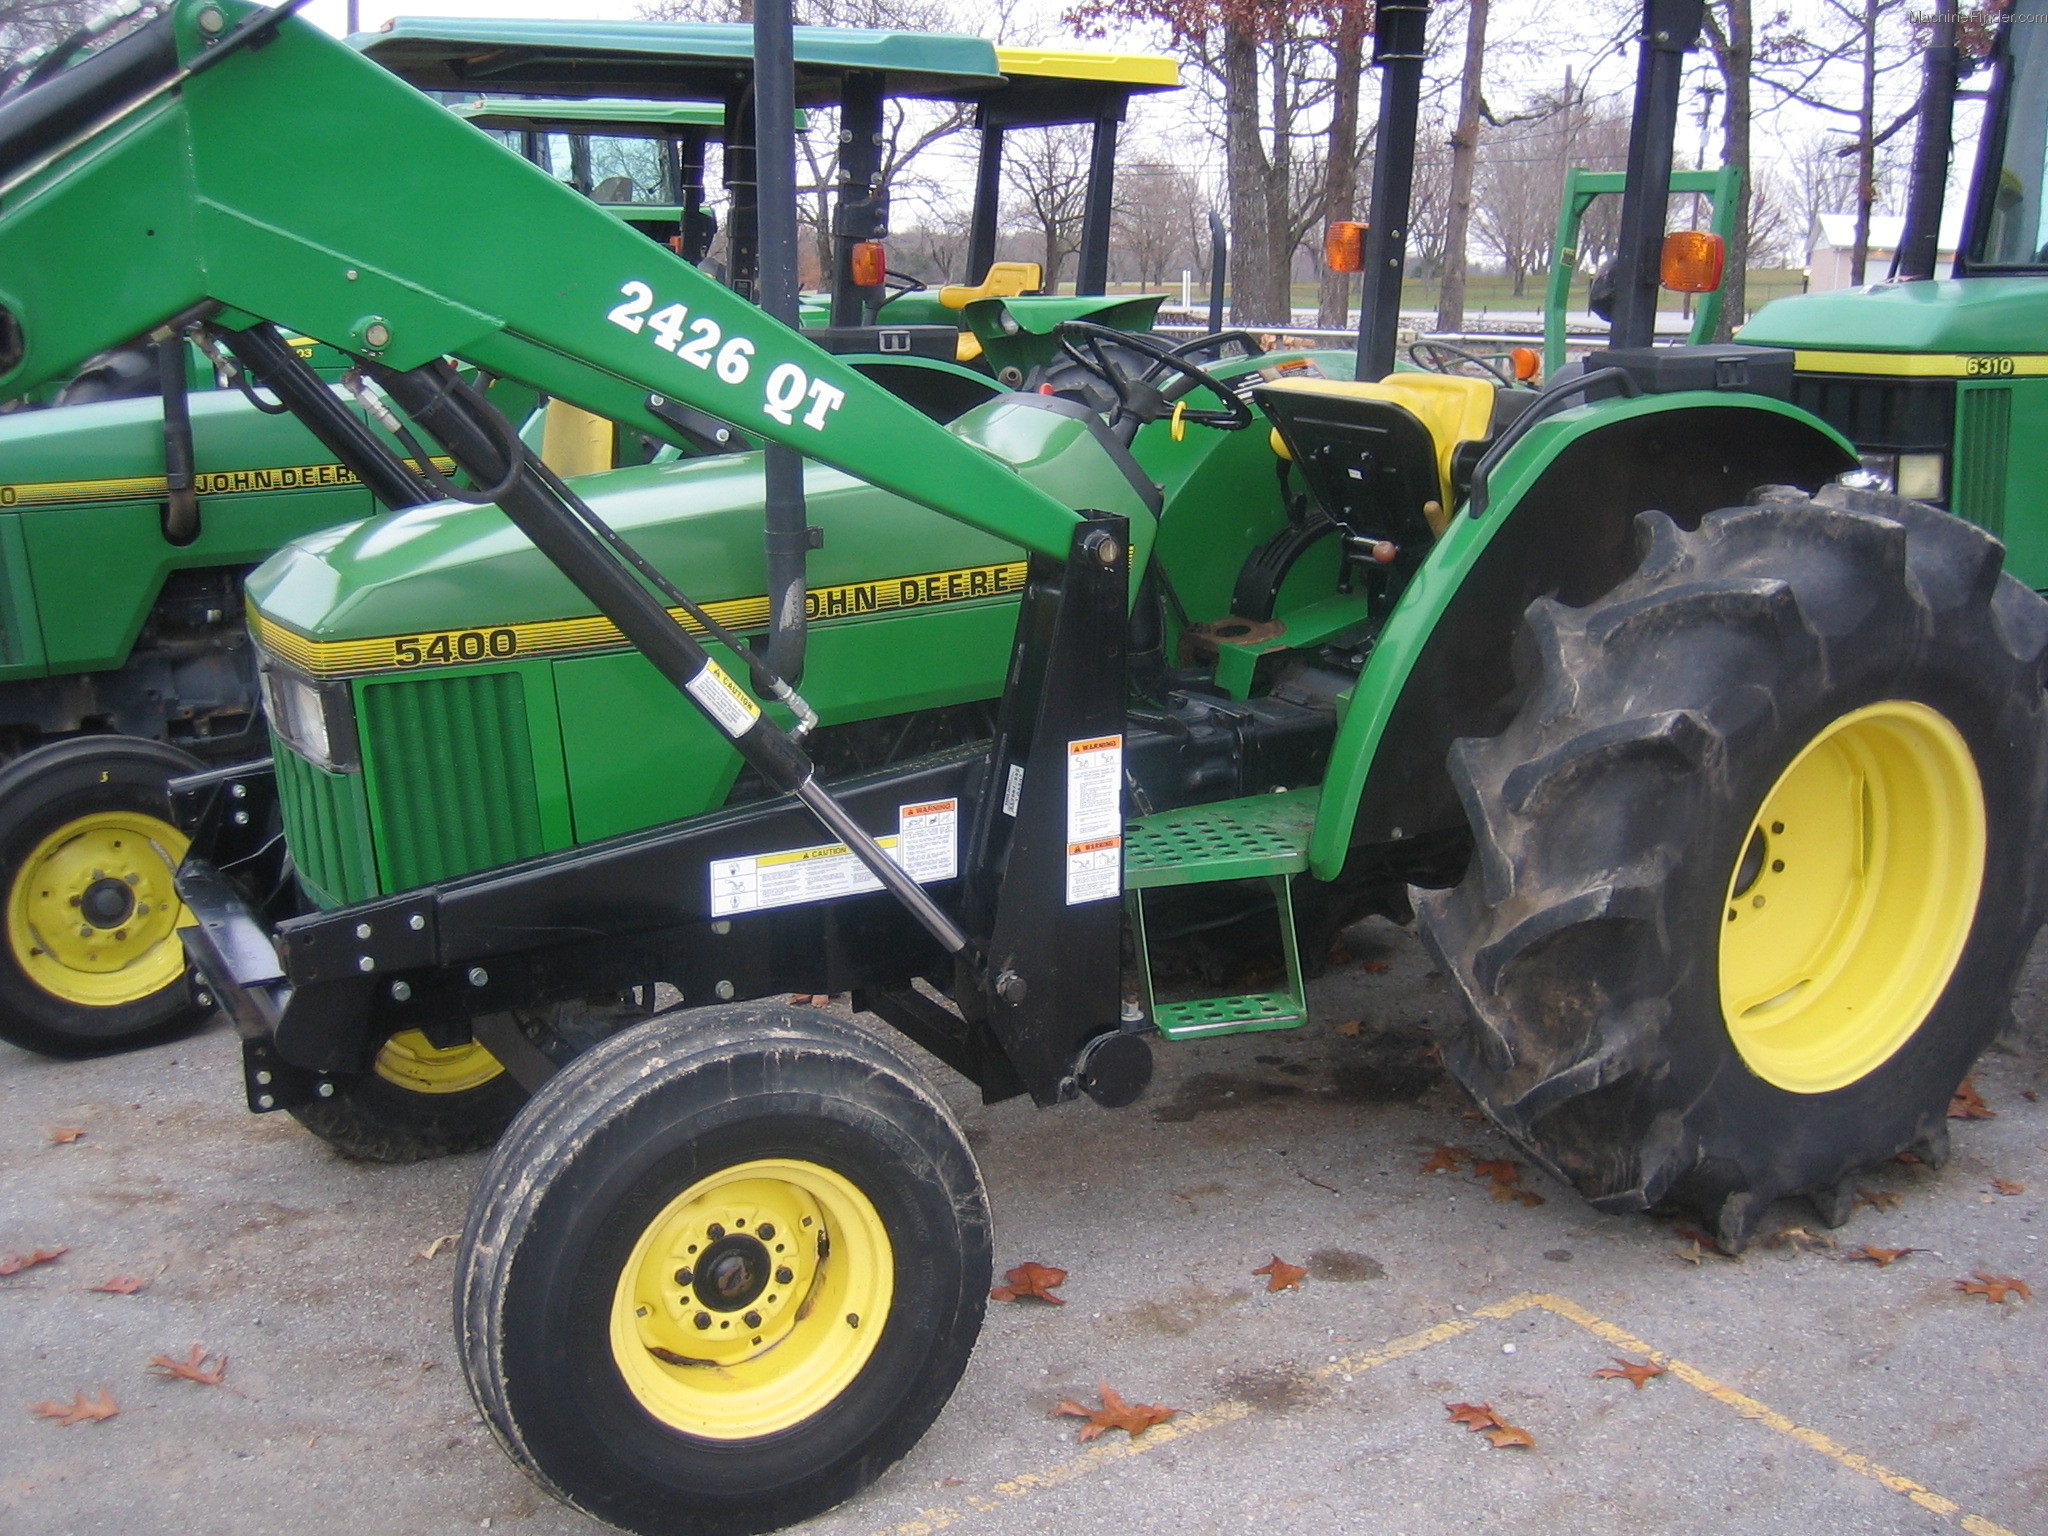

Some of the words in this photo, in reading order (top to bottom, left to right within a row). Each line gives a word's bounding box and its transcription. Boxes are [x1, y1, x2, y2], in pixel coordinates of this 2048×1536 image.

[607, 281, 756, 385] 2426
[763, 363, 846, 431] QT
[1966, 357, 2013, 375] 6310
[195, 469, 272, 494] JOHN
[281, 465, 356, 488] DEER
[806, 585, 877, 618] OHN
[900, 567, 1009, 606] DEERE
[394, 629, 517, 667] 5400
[722, 676, 753, 712] CAUTION
[1082, 740, 1117, 752] WARNING
[915, 802, 951, 814] WARNING
[811, 846, 848, 858] CAUTION
[1085, 840, 1114, 851] WARNING
